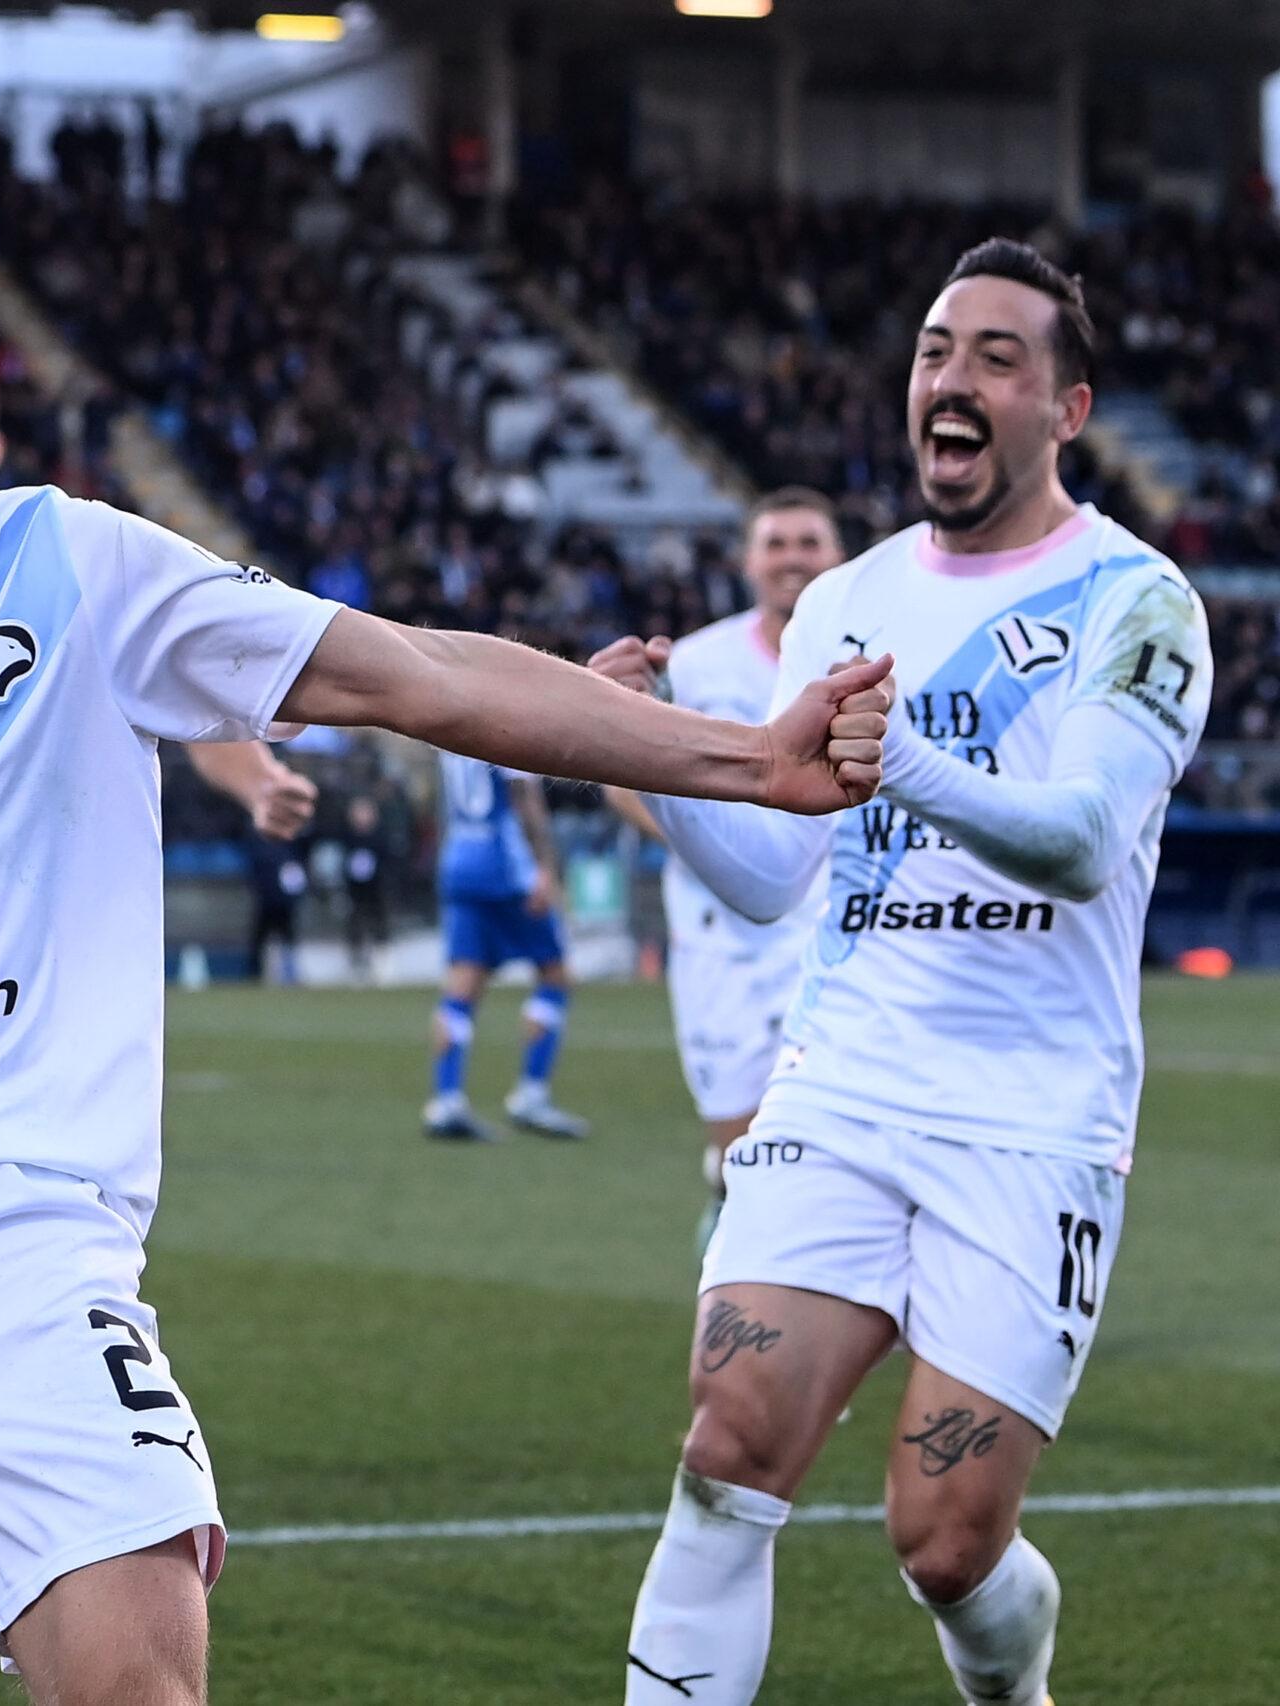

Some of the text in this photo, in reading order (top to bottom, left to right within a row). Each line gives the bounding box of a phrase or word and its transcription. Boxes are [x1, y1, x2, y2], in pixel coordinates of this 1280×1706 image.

[841, 892, 1055, 934] Bisaten
[1058, 1211, 1102, 1318] 10
[87, 1308, 181, 1412] 2
